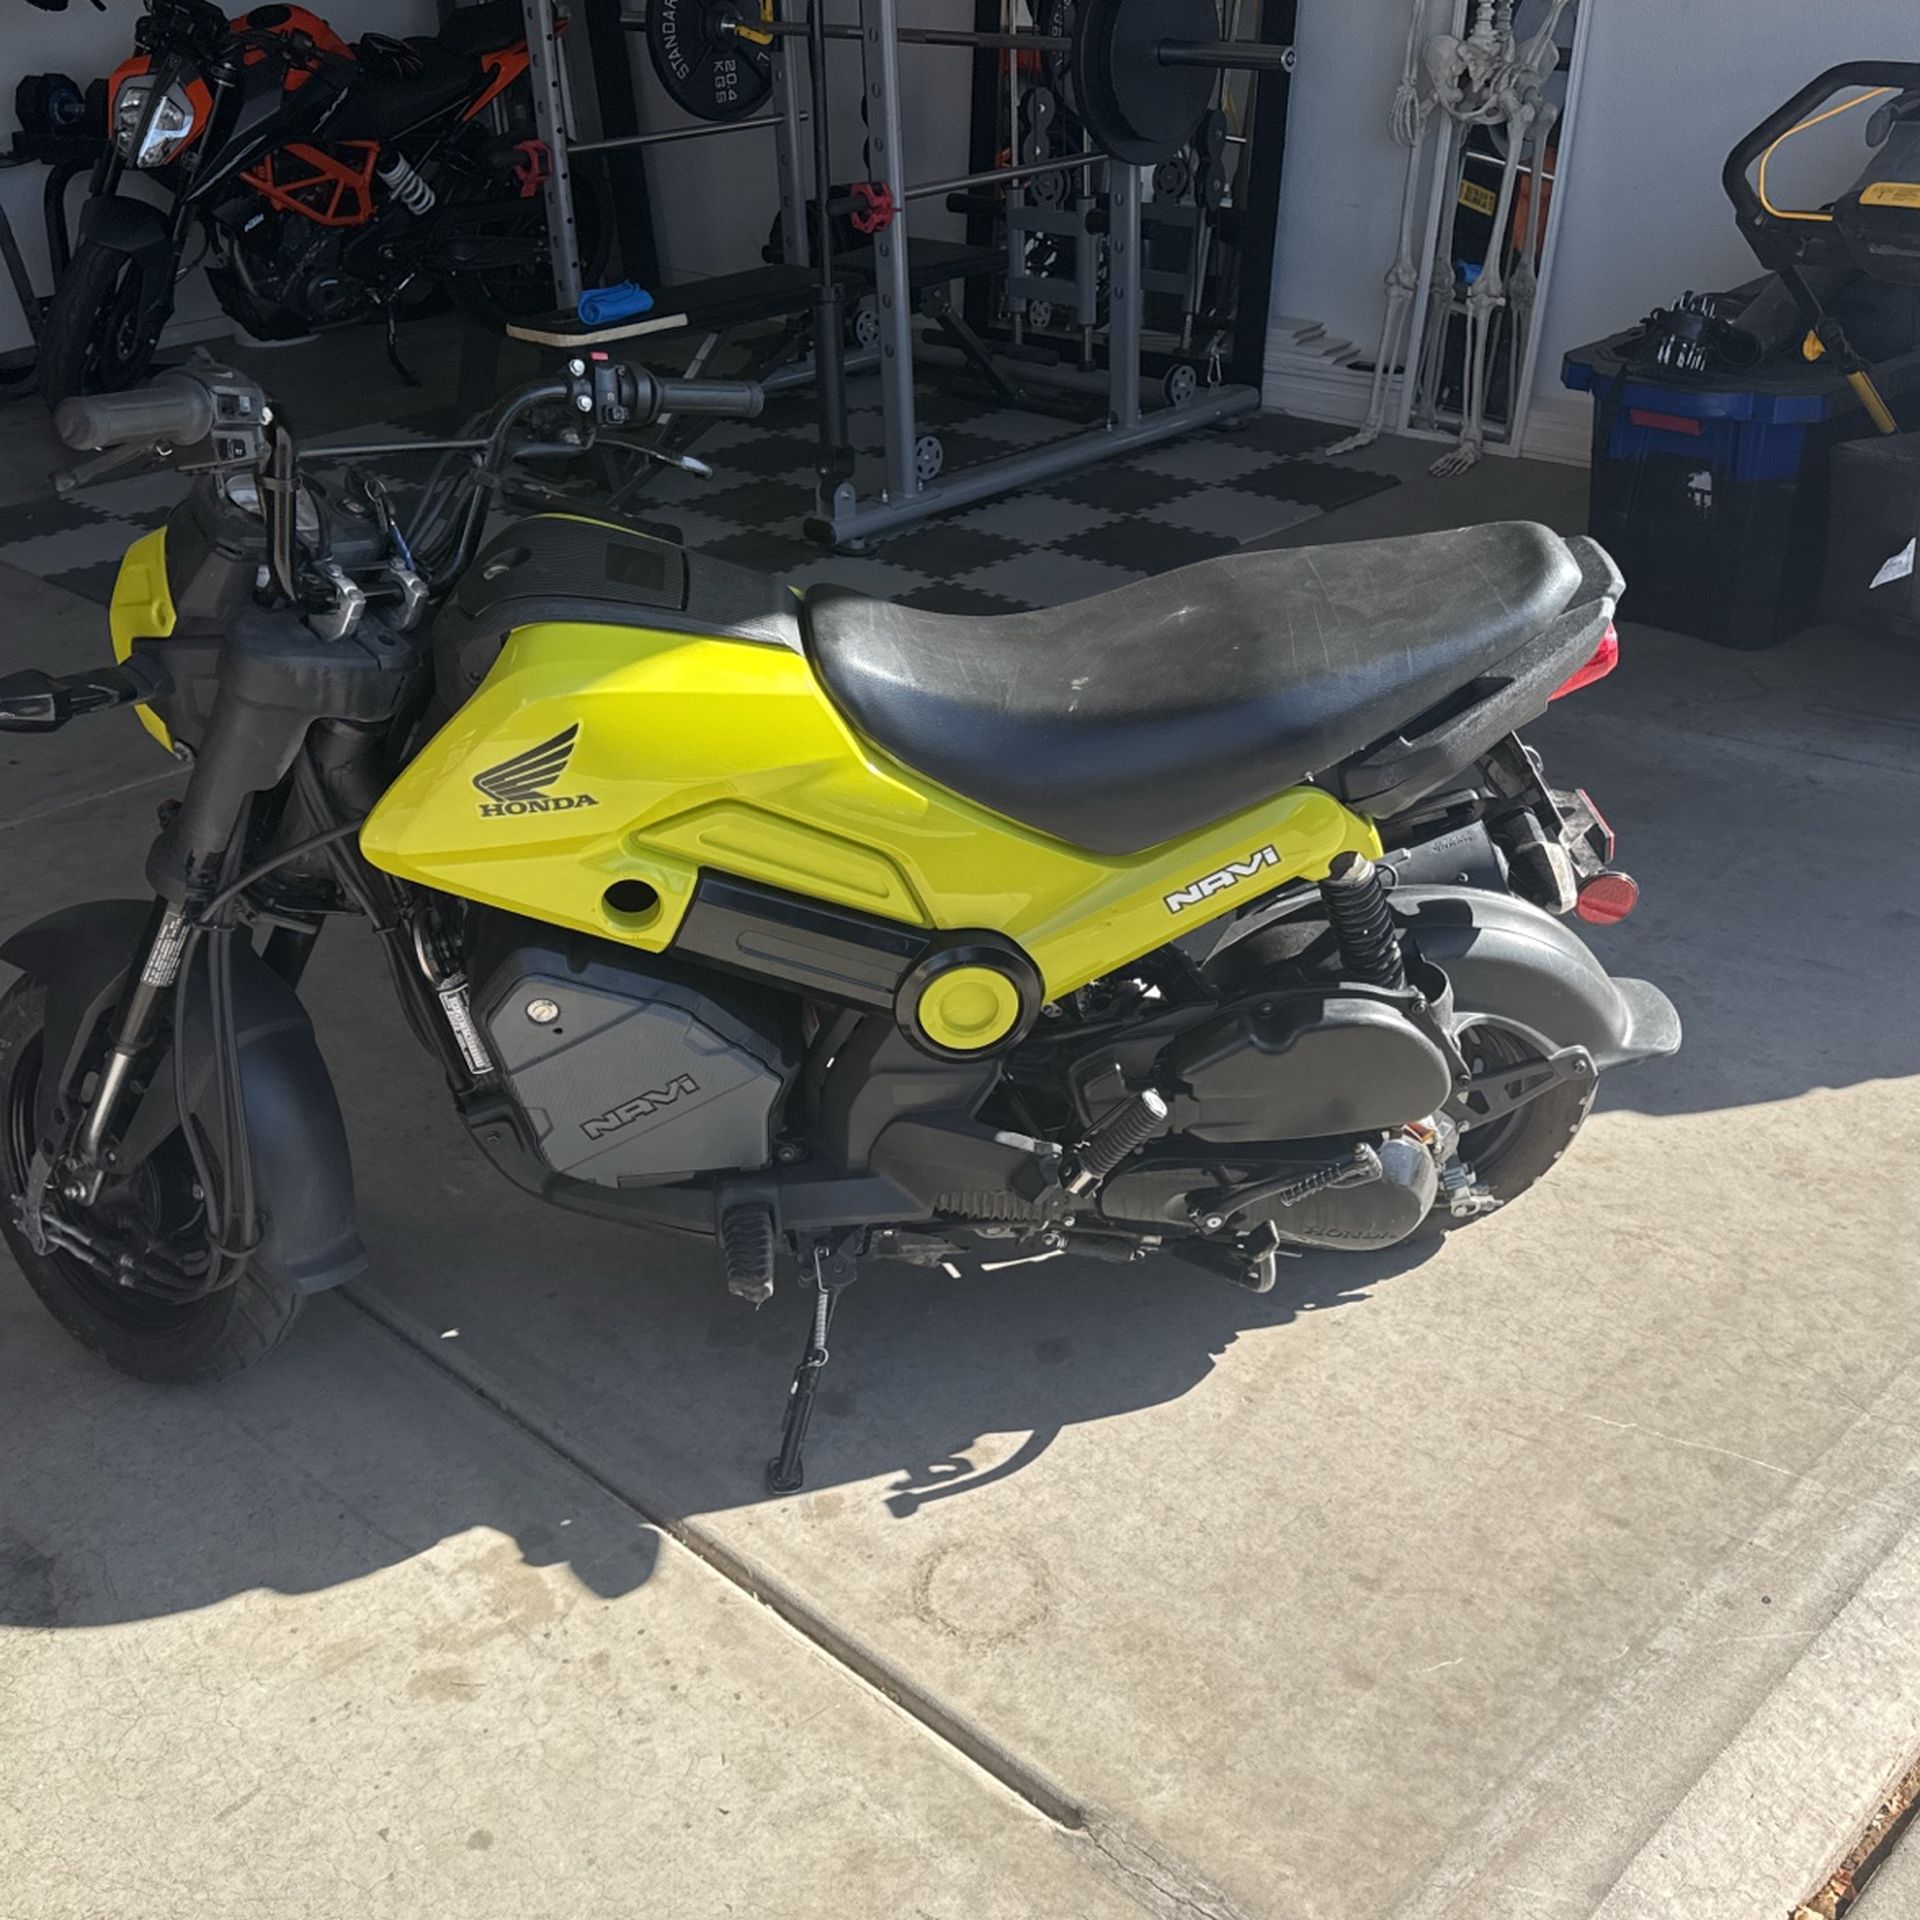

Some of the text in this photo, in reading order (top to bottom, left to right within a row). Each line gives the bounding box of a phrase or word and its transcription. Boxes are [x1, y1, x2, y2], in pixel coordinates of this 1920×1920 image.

[713, 60, 727, 104] KGS
[725, 59, 738, 102] 20.4
[479, 793, 600, 817] HONDA
